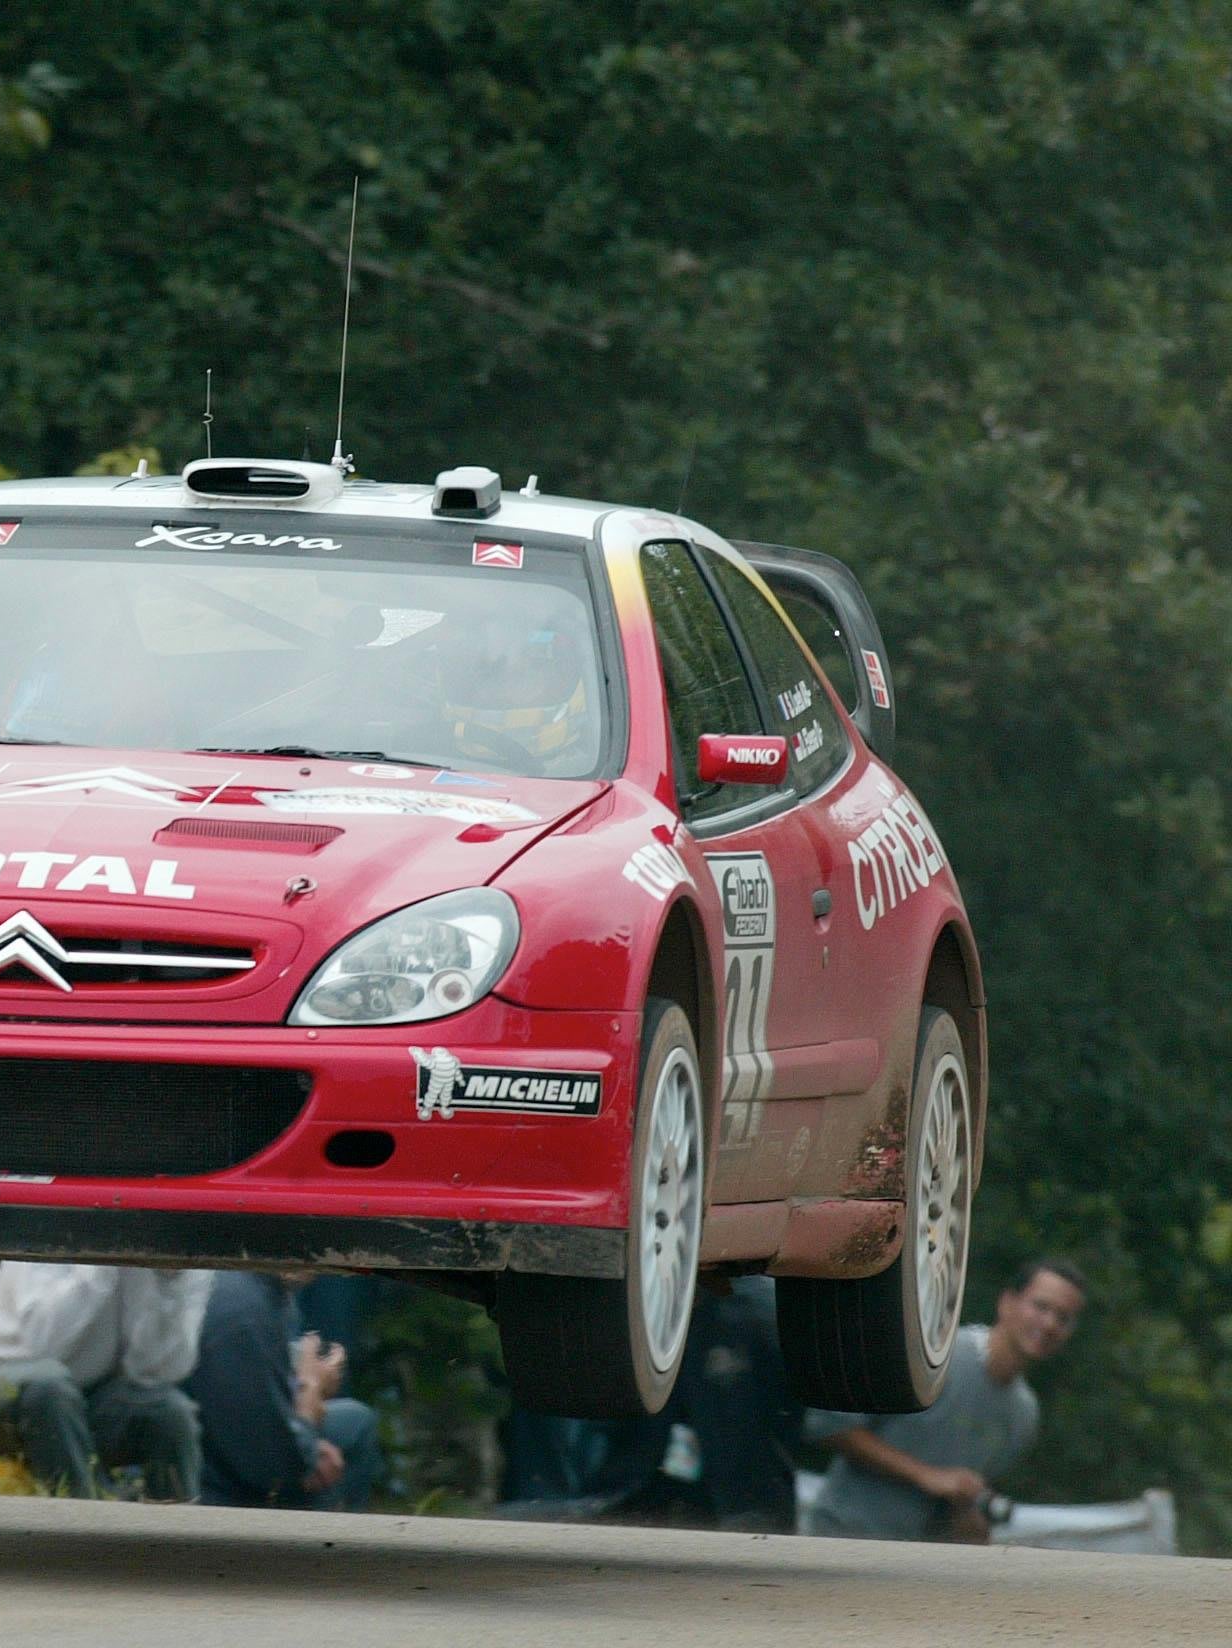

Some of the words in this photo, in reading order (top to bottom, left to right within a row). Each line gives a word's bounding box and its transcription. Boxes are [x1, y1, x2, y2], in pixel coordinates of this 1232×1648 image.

[135, 525, 342, 550] Xsara
[726, 748, 780, 766] NIKKO
[464, 1075, 598, 1104] MICHELIN
